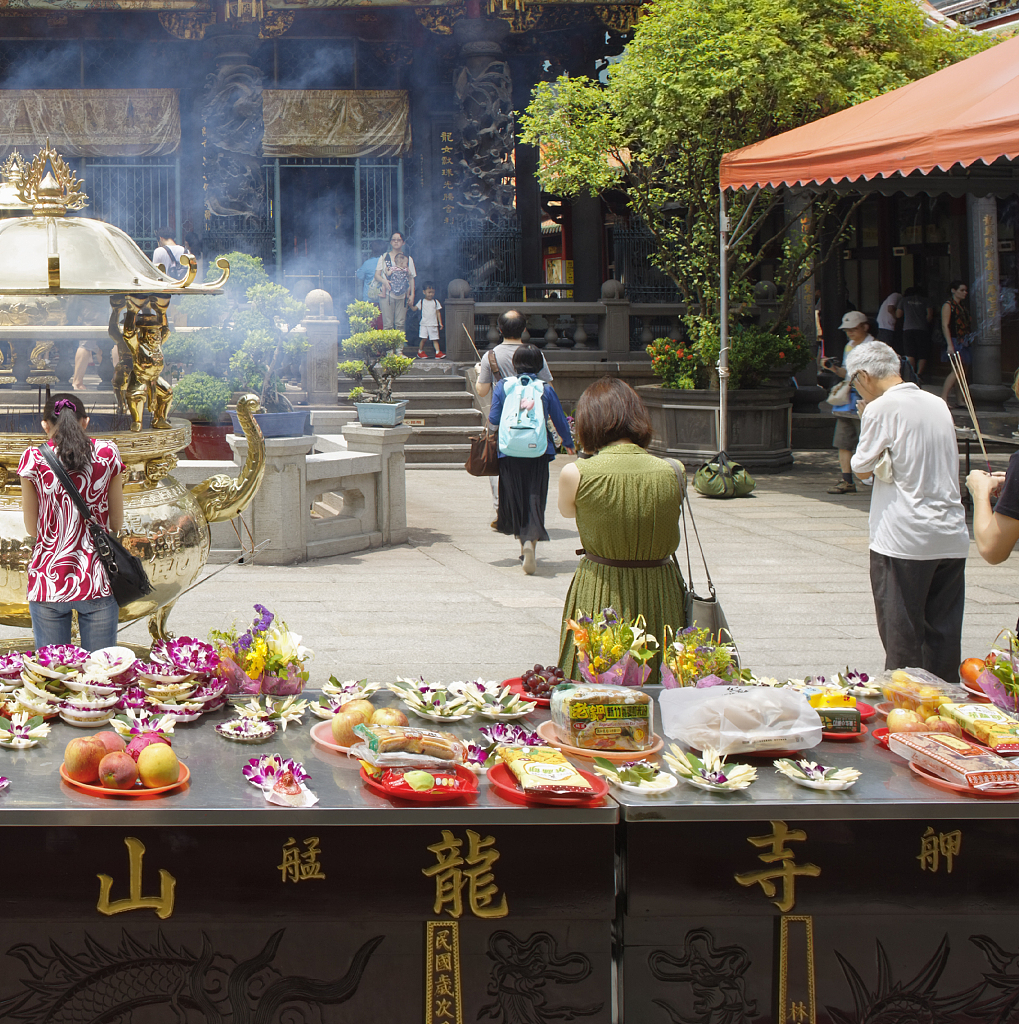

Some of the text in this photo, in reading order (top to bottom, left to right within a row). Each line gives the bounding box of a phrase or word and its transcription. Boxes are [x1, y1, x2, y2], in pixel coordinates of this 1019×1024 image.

[422, 828, 509, 919] 龍
[434, 929, 455, 1024] 民國歲次
[786, 1000, 809, 1024] 林
